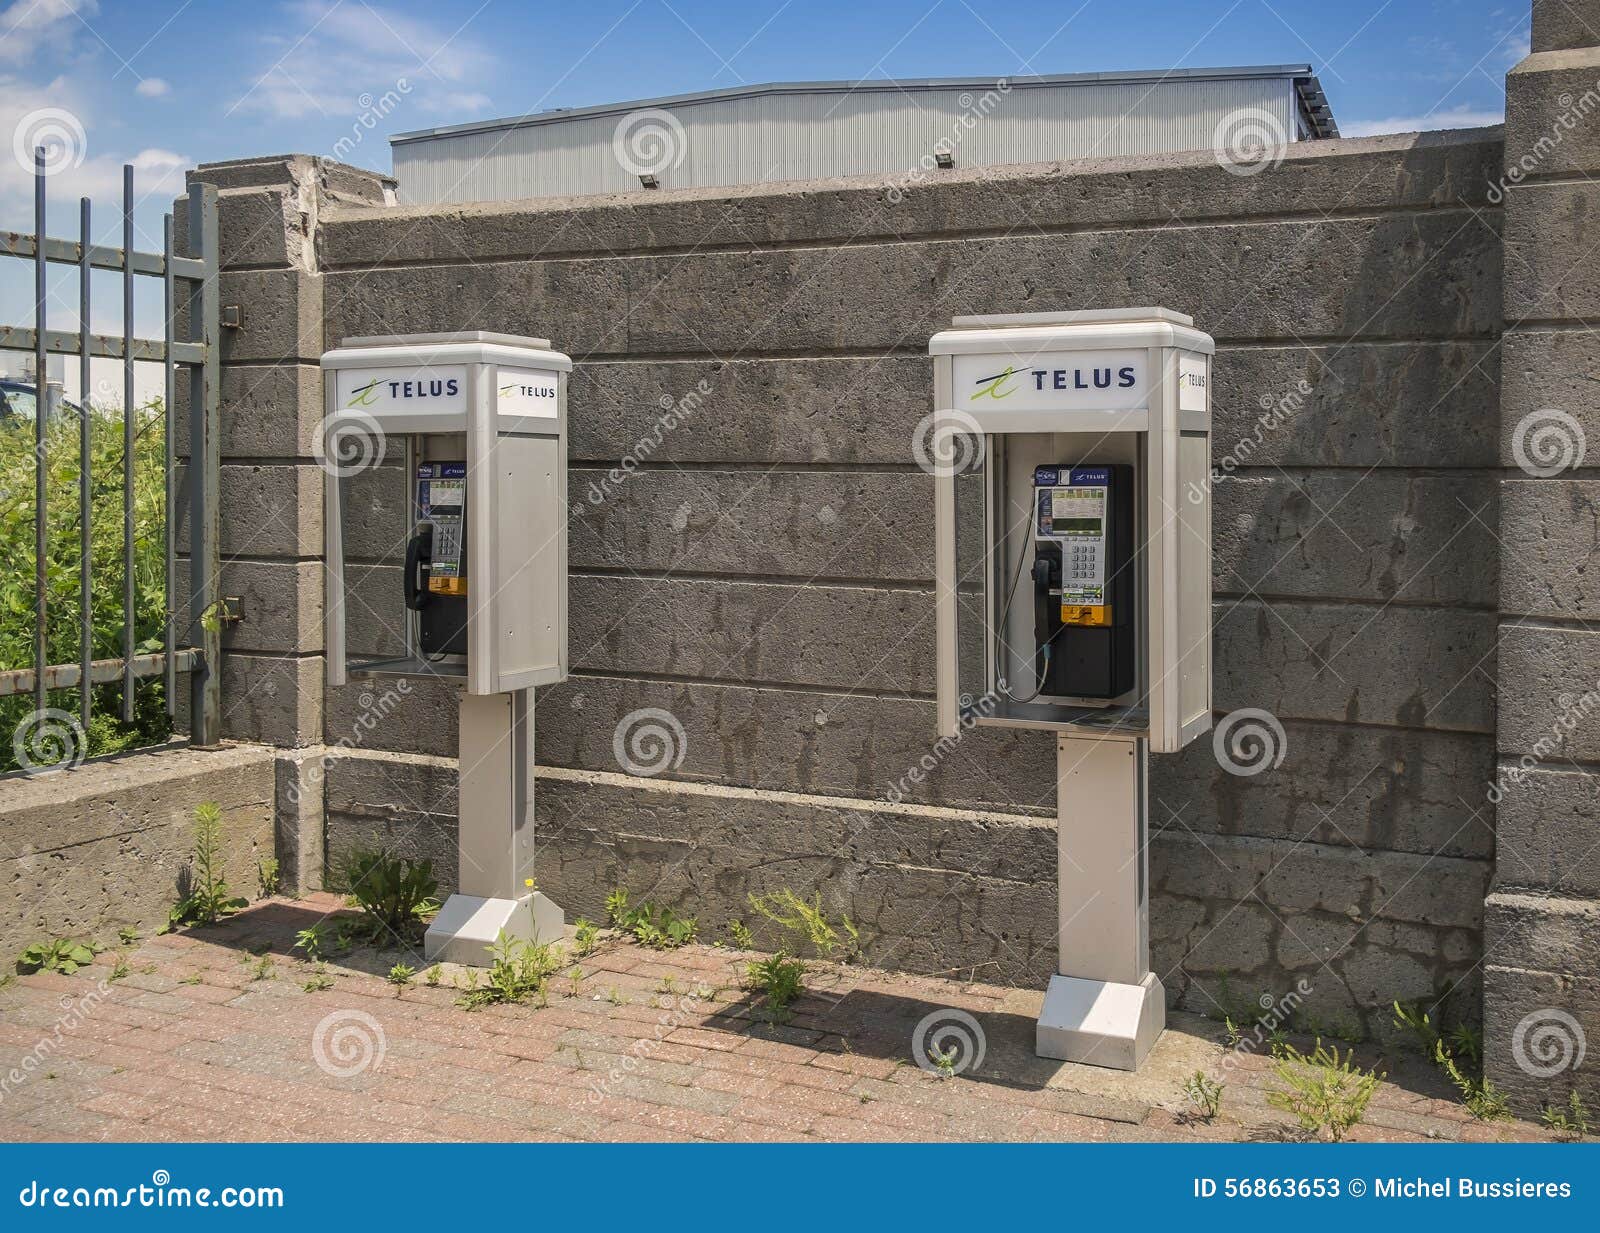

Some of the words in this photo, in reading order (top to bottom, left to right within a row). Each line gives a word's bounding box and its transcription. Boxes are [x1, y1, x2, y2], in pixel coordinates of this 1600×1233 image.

[1031, 367, 1136, 390] TELUS
[1188, 373, 1206, 388] TELUS
[389, 379, 459, 398] TELUS
[520, 385, 555, 398] TELUS
